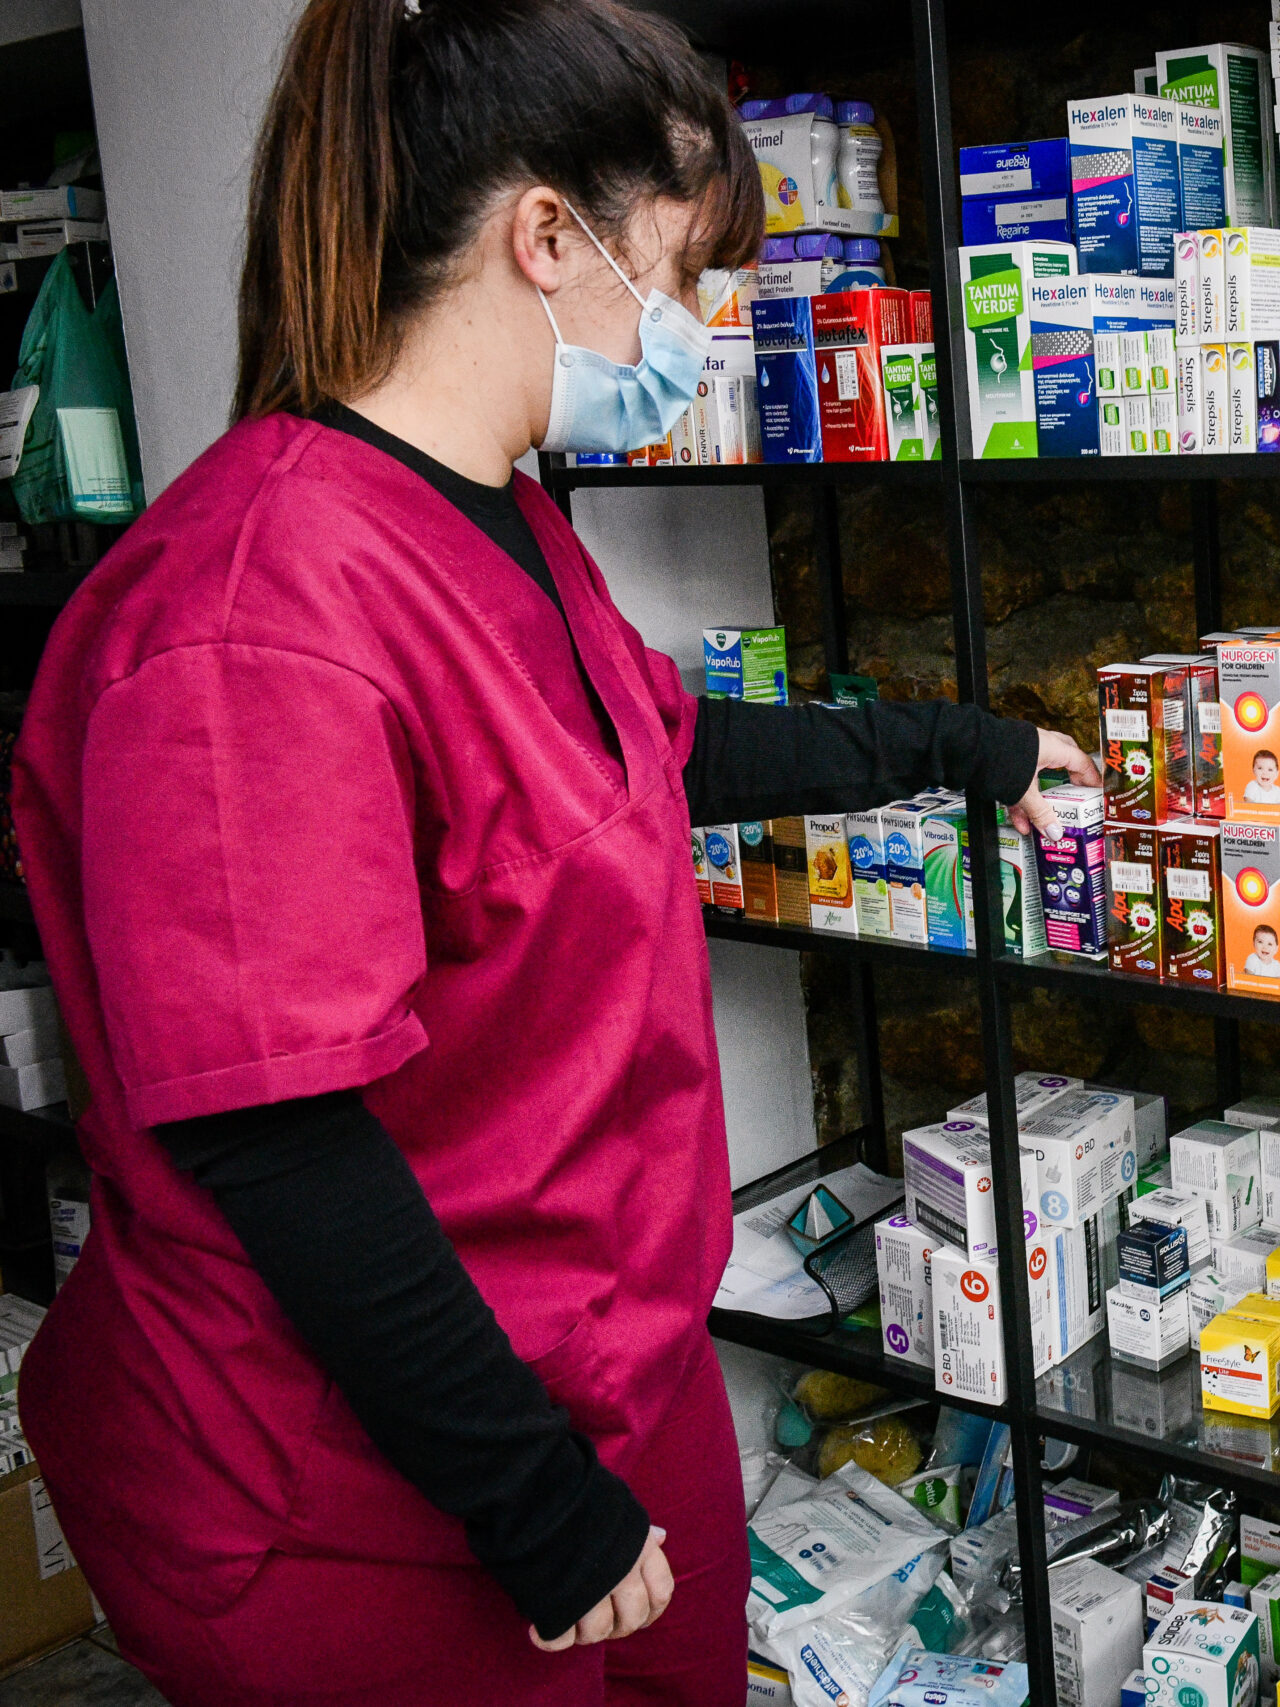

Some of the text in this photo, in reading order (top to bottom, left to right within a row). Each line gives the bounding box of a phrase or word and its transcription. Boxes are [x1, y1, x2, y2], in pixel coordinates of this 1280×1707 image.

[1165, 84, 1215, 100] TANTUM
[1072, 107, 1126, 124] Hexalen
[1133, 105, 1173, 122] Hexalen
[1181, 112, 1219, 130] Hexalen
[996, 155, 1030, 169] Regaine
[997, 224, 1029, 240] Regaine
[758, 271, 792, 285] ortimel
[968, 283, 1019, 299] TANTUM
[1032, 285, 1087, 301] Hexalen
[1095, 283, 1135, 299] Hexalen
[973, 298, 1016, 314] VERDE
[818, 327, 866, 344] Botafex
[885, 365, 913, 375] TANTUM
[888, 373, 910, 382] VERDE
[752, 634, 780, 644] VapoRub
[706, 655, 741, 668] VapoRub
[1221, 650, 1275, 663] NUROFEN
[1235, 663, 1265, 671] CHILDREN
[847, 813, 877, 823] PHYSIOMER
[884, 818, 915, 829] PHYSIOMER
[924, 831, 954, 841] Vibrocil-S
[1223, 825, 1275, 840] NUROFEN
[1236, 839, 1265, 848] CHILDREN
[1084, 1138, 1095, 1153] BD
[943, 1352, 951, 1370] BD
[1206, 1354, 1241, 1368] FreeStyle
[924, 1478, 936, 1507] Dettol
